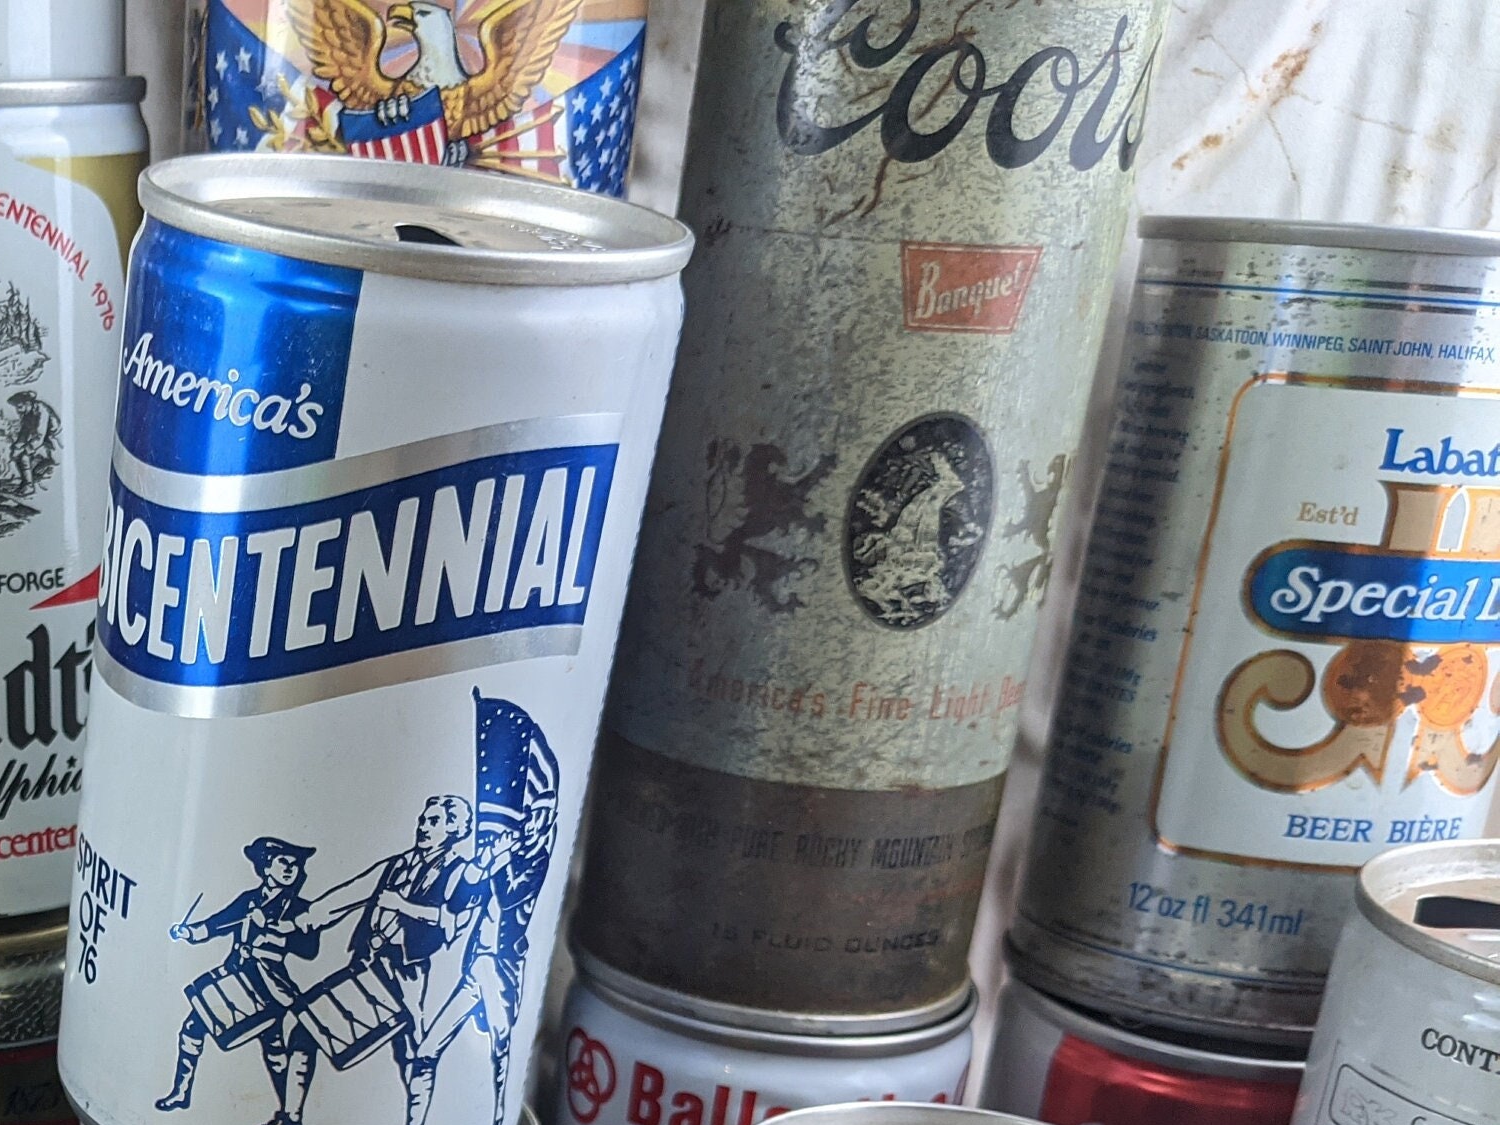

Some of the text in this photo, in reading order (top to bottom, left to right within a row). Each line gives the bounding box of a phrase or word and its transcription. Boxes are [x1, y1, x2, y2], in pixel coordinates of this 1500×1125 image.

[773, 0, 1162, 172] Coors
[90, 282, 117, 332] 1976
[915, 259, 1025, 321] Banquet
[1349, 338, 1393, 356] SAINT
[122, 331, 324, 440] America's
[1296, 502, 1359, 526] Est'd
[97, 466, 597, 666] BICENTENNIAL
[1270, 566, 1474, 623] Special
[1283, 813, 1463, 844] BEER BIÈRE
[75, 830, 137, 921] SPIRIT
[1129, 881, 1208, 923] 12 oz fl
[79, 891, 108, 945] OF
